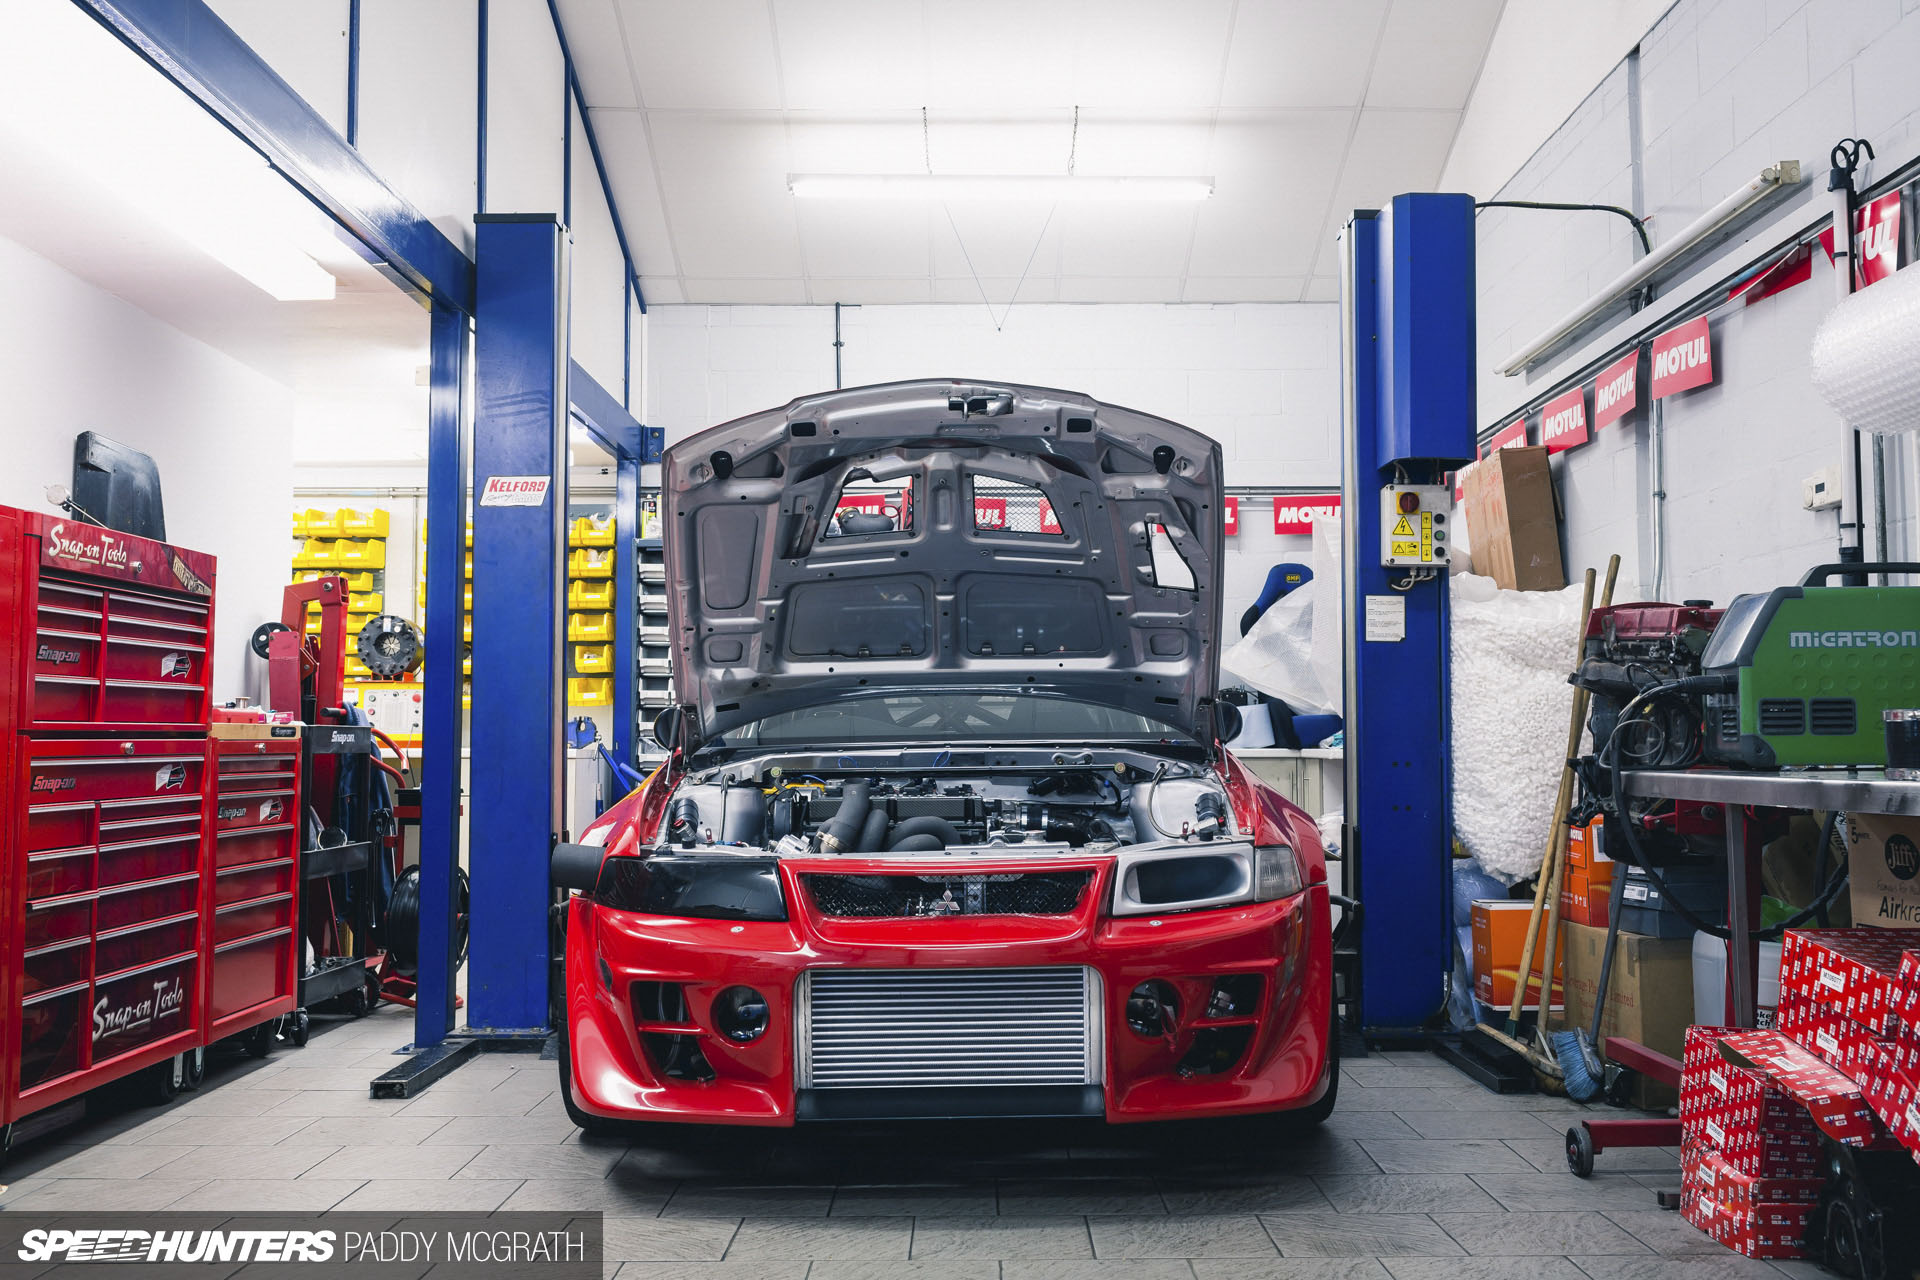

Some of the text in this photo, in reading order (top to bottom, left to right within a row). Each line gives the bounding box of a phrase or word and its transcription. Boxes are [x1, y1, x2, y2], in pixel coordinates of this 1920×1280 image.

[1854, 219, 1896, 265] TUL
[1654, 335, 1709, 380] MOTUL
[1597, 365, 1635, 415] MOTUL
[1544, 402, 1584, 441] MOTUL
[489, 479, 546, 493] KELFORD
[1278, 505, 1341, 523] MOTU
[49, 524, 127, 564] Snap-on Tools
[37, 645, 80, 665] Snap-on
[331, 730, 355, 744] Snap-on
[33, 775, 75, 792] Snap-on
[218, 806, 246, 820] Snap-on
[93, 977, 183, 1040] Snap-on Tools
